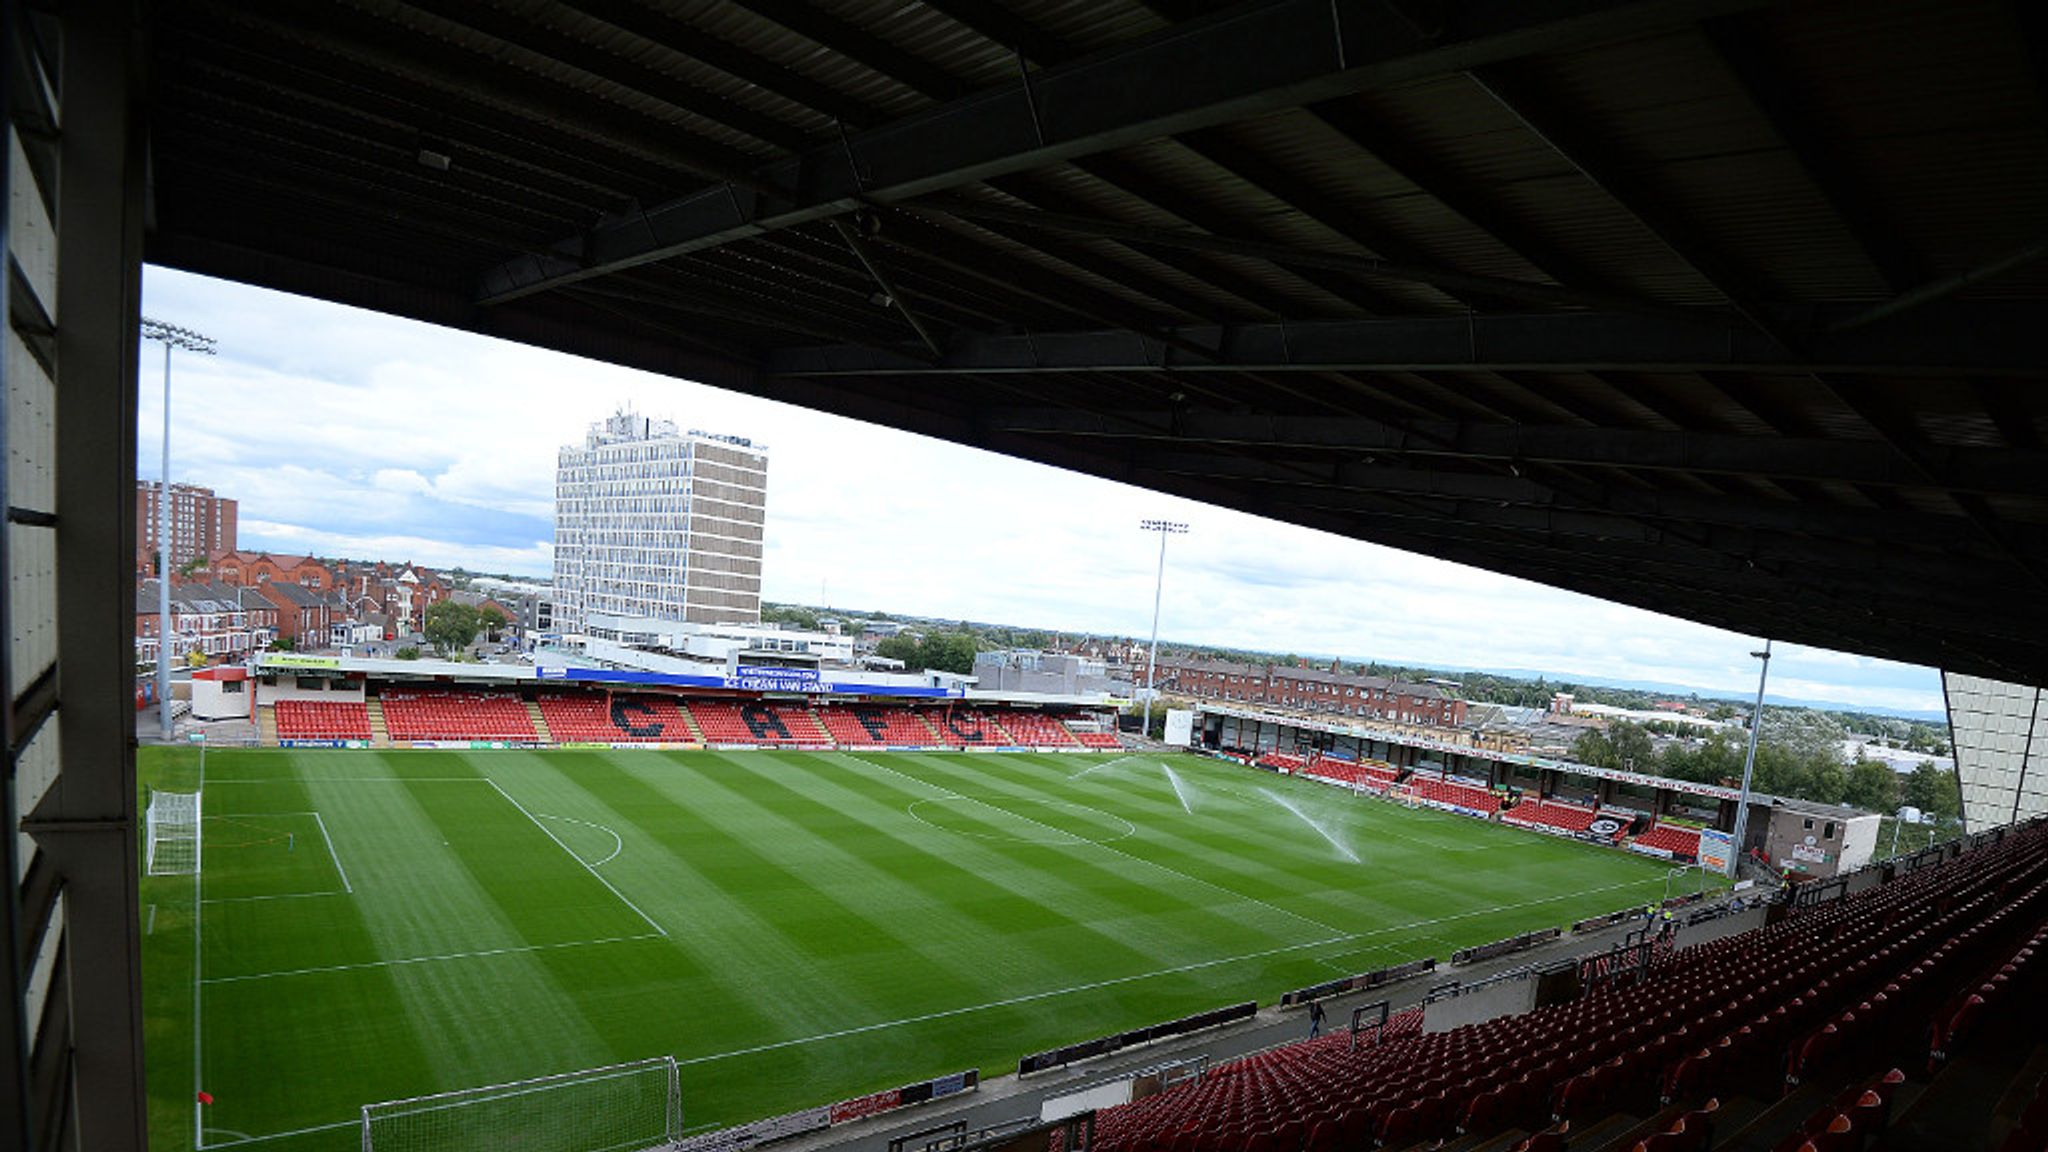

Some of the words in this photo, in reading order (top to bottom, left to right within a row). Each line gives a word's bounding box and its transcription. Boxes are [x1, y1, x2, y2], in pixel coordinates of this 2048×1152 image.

[724, 678, 739, 689] ICE
[742, 679, 777, 690] CREAM
[780, 680, 800, 692] VAN
[802, 682, 833, 693] STAND
[610, 701, 665, 737] C
[741, 704, 793, 739] A
[854, 710, 889, 741] F
